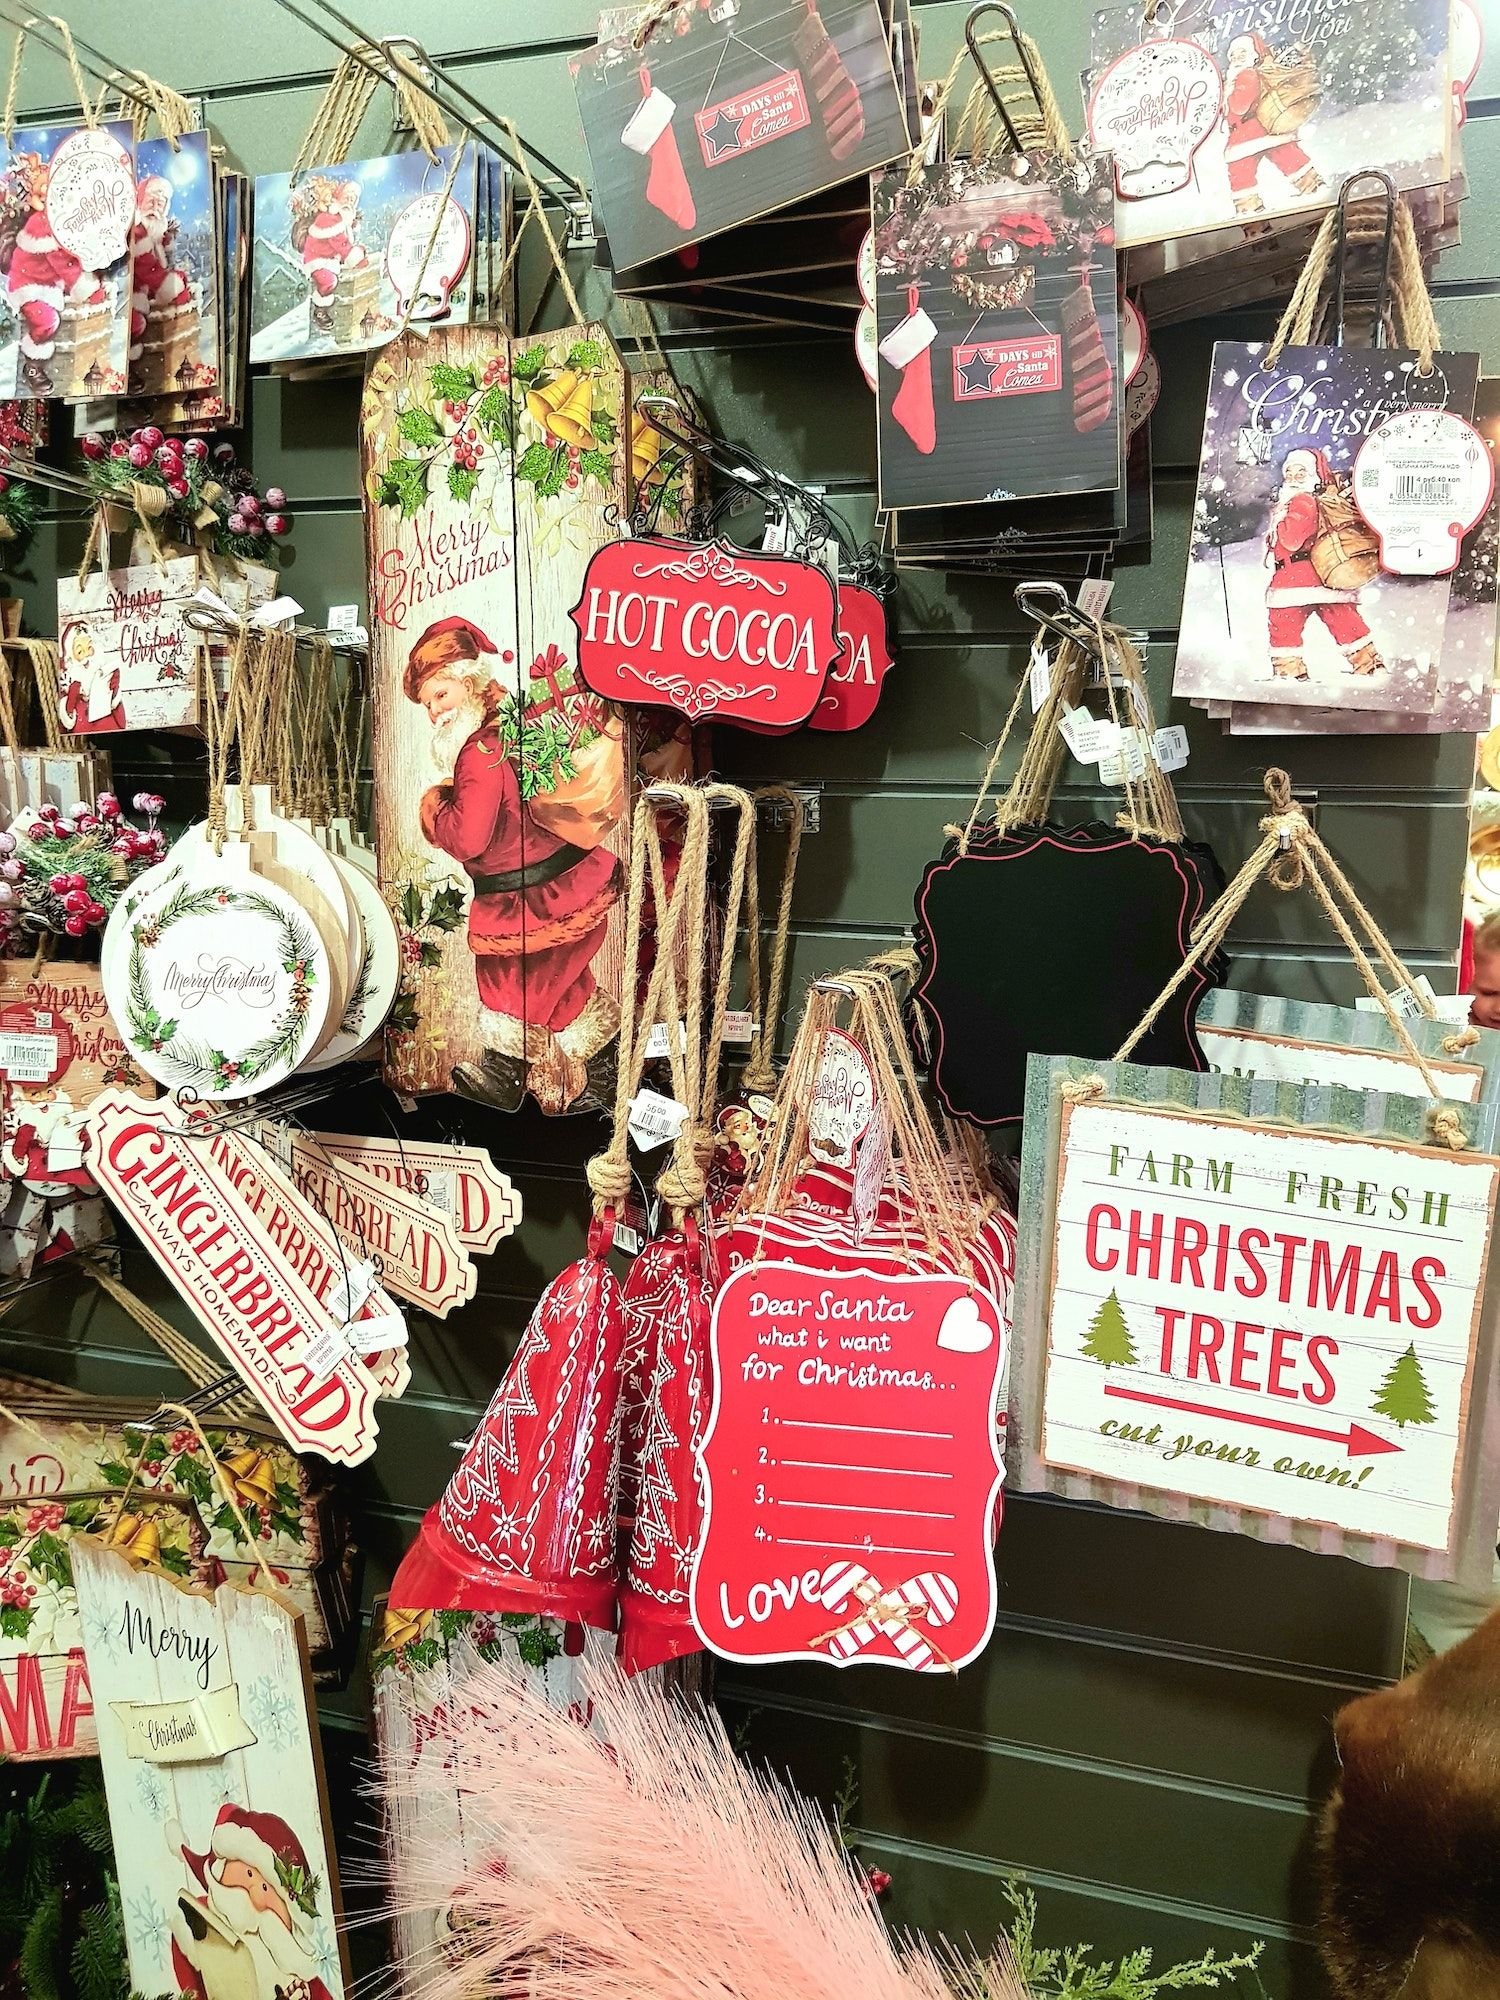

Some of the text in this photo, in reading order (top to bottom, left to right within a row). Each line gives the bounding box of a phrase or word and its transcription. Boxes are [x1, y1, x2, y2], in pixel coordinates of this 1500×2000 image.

[741, 95, 772, 117] DAYS
[761, 100, 794, 120] Santa
[751, 114, 791, 139] Comes
[1000, 350, 1029, 363] DAYS
[1017, 362, 1049, 373] Santa
[1003, 368, 1043, 388] Comes
[1242, 371, 1399, 437] Christ
[407, 510, 489, 570] Merry
[107, 587, 162, 623] Merry
[375, 542, 513, 630] Christmas
[121, 624, 187, 668] Christmas
[584, 588, 819, 675] HOT COCOA
[27, 983, 109, 1022] Merry
[163, 961, 214, 1009] Merry
[1108, 1143, 1451, 1228] FARM FRESH
[108, 1122, 351, 1432] GINGERBREAD
[1085, 1203, 1447, 1330] CHRISTMAS
[139, 1201, 281, 1385] ALWAYS HOMEMADE
[748, 1290, 915, 1323] Dear Santa
[757, 1326, 892, 1353] what i want
[1154, 1306, 1340, 1405] TREES
[740, 1353, 784, 1383] for
[761, 1407, 781, 1425] 1.
[757, 1446, 778, 1466] 2.
[1099, 1416, 1376, 1490] cut your own!
[753, 1484, 775, 1505] 3.
[753, 1525, 773, 1542] 4.
[719, 1568, 821, 1629] Love
[119, 1600, 219, 1690] Merry
[139, 1714, 198, 1751] Christmas
